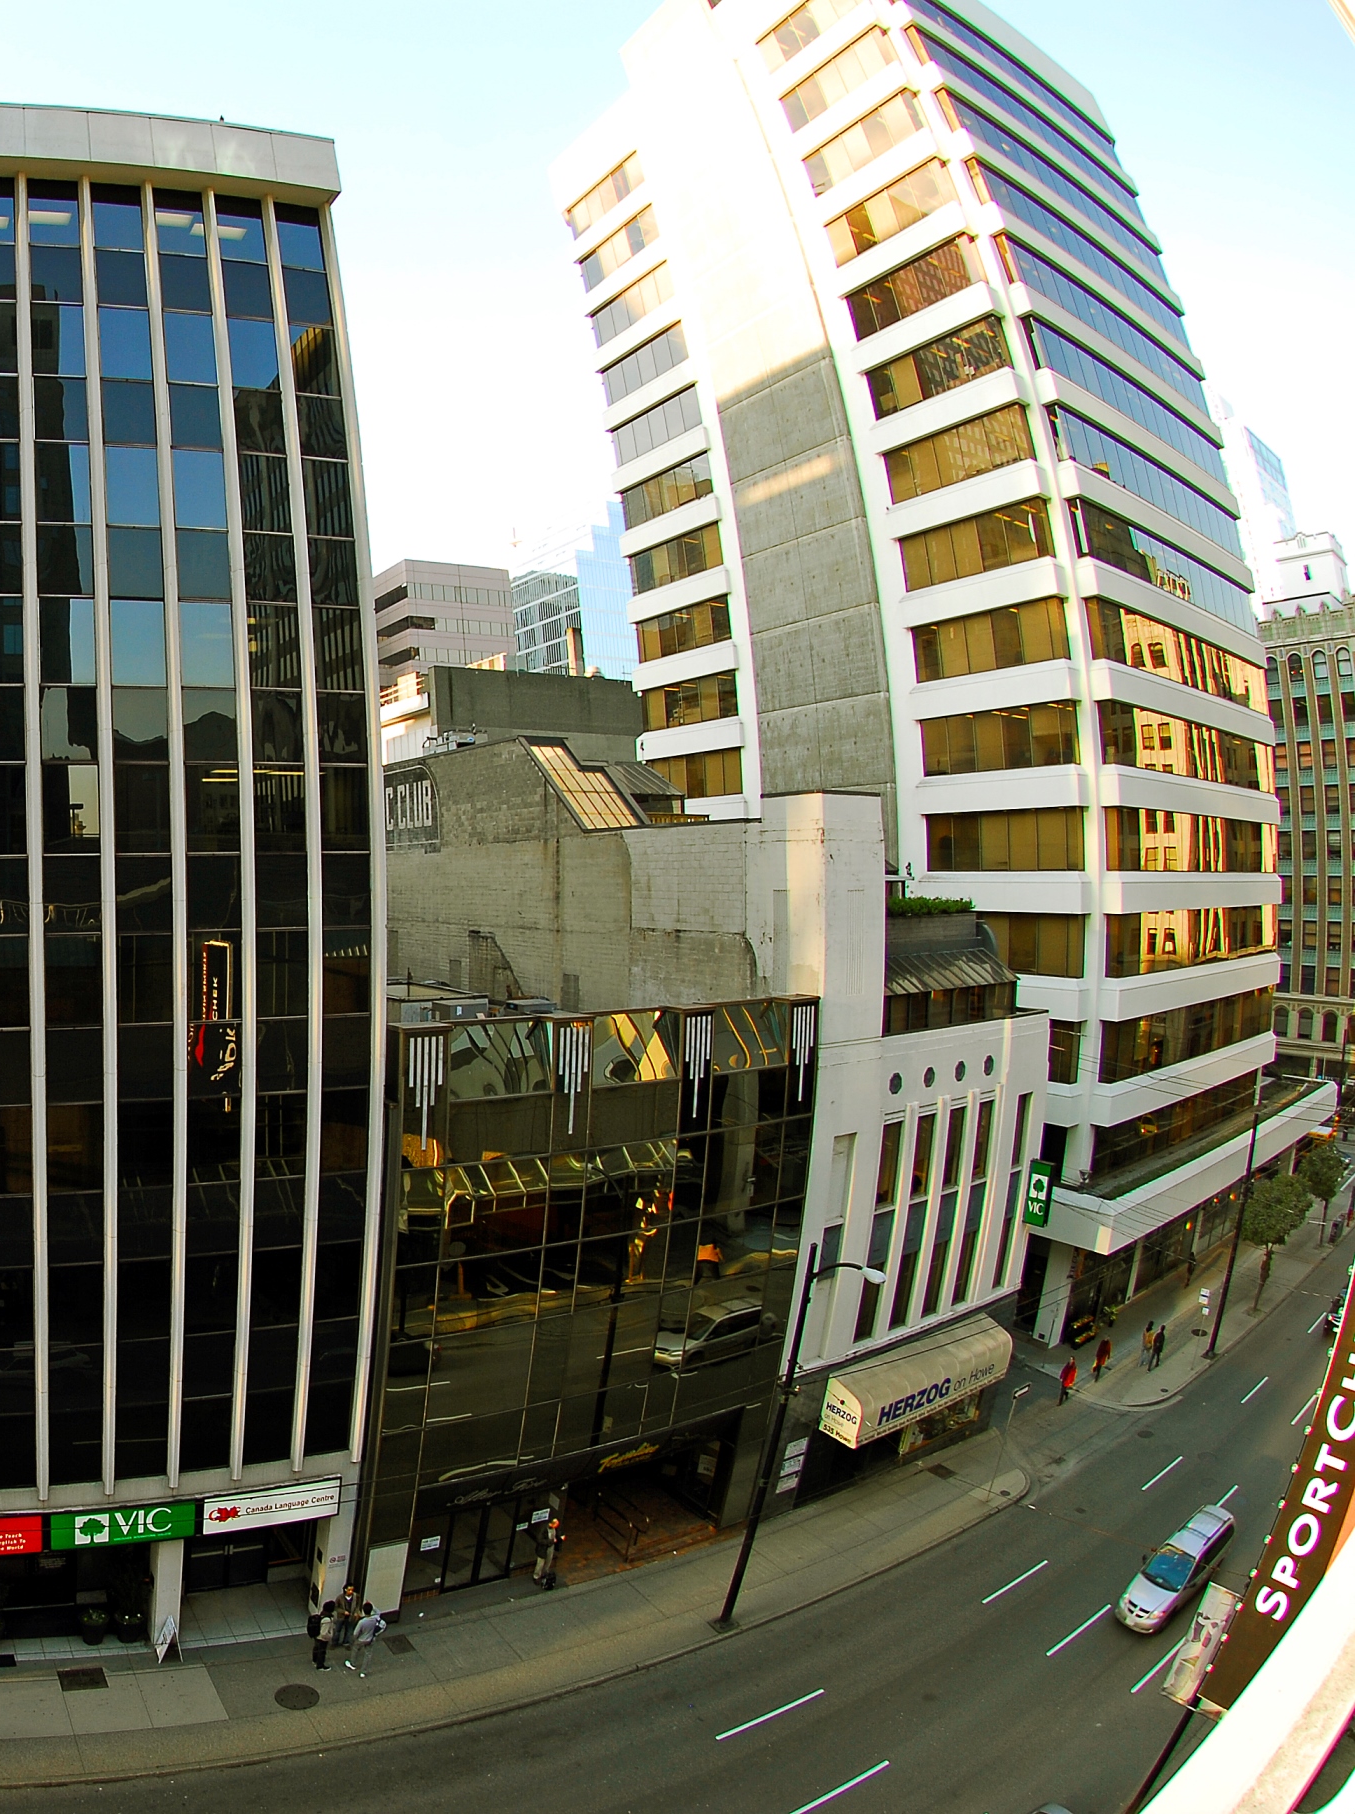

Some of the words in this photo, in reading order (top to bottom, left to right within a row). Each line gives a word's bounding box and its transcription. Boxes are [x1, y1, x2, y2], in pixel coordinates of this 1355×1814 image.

[397, 779, 432, 829] CLUB
[1028, 1200, 1044, 1215] VIC
[877, 1377, 952, 1427] HERZOG
[953, 1377, 966, 1392] on
[968, 1363, 995, 1384] Howe
[825, 1401, 857, 1425] HERZOG
[245, 1504, 274, 1514] Canada
[274, 1499, 310, 1511] Language
[311, 1494, 335, 1504] Centre
[114, 1507, 172, 1536] VIC
